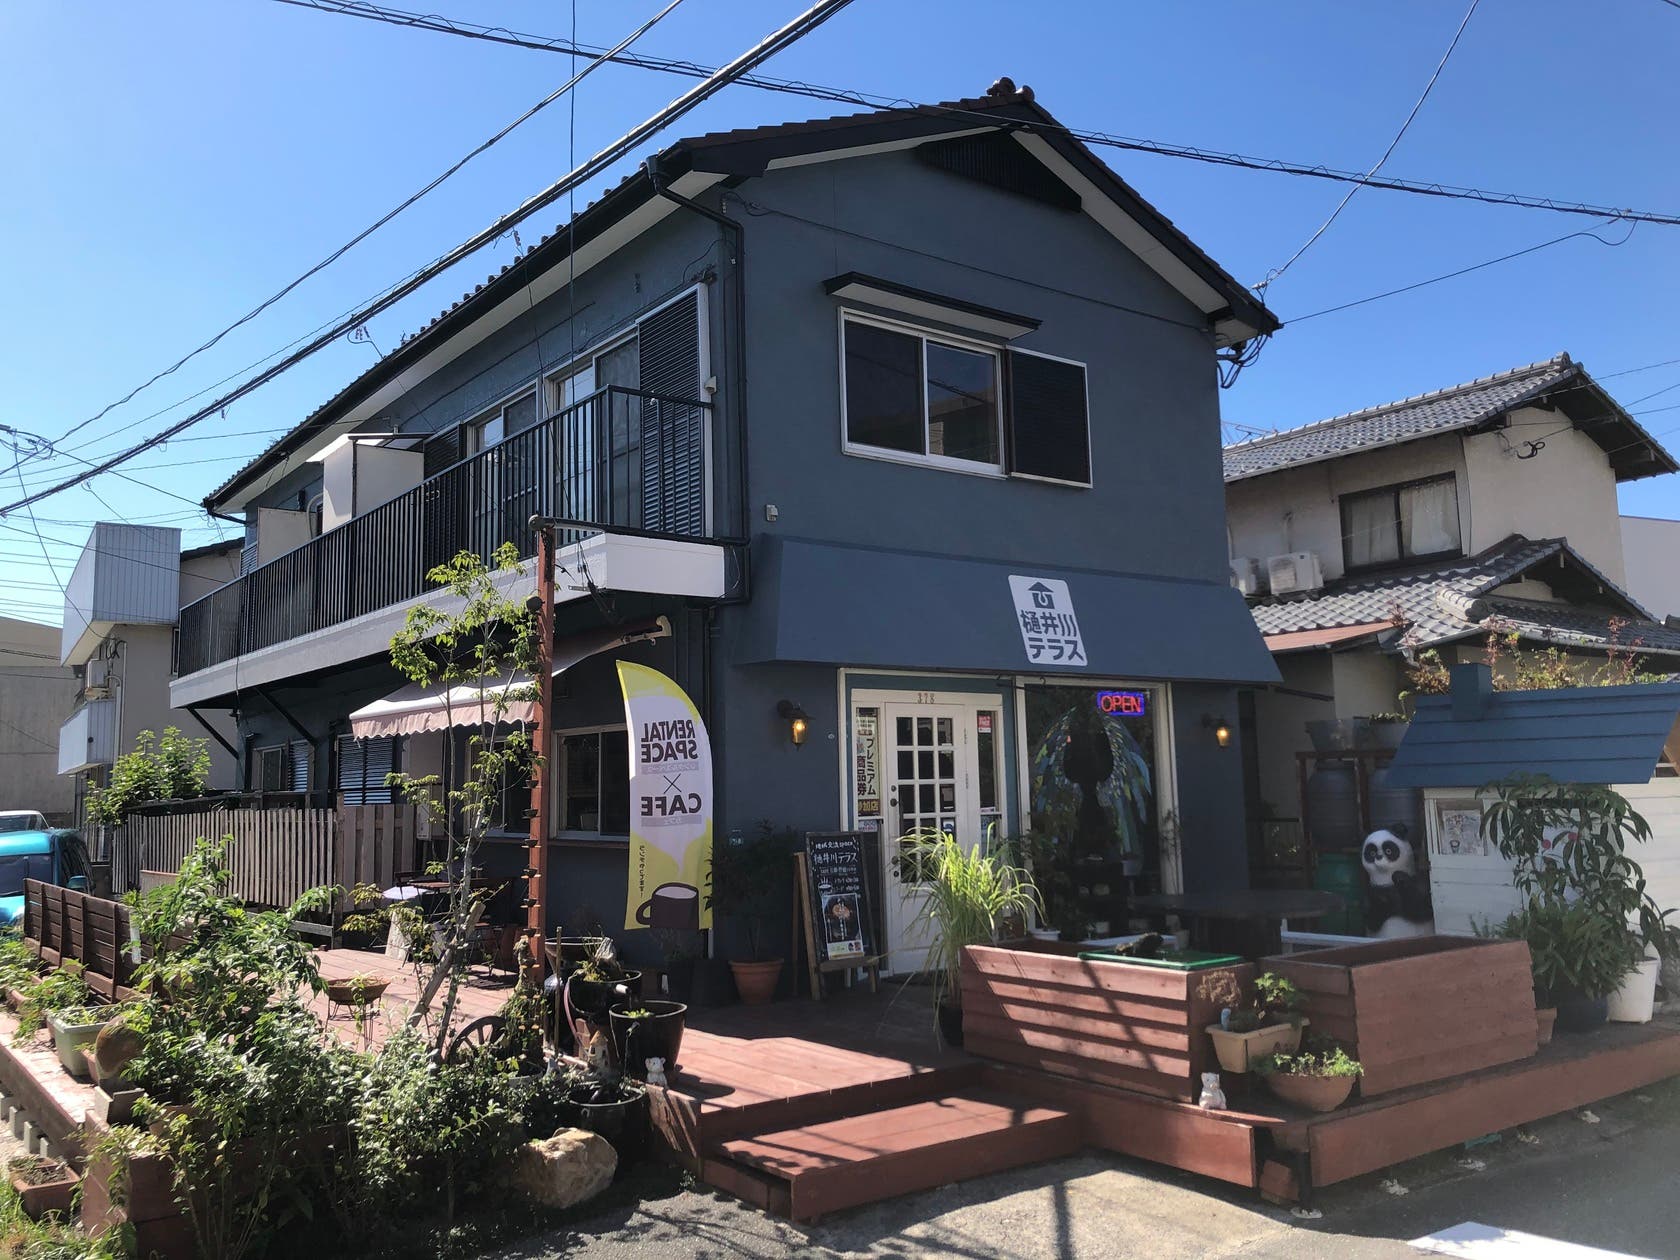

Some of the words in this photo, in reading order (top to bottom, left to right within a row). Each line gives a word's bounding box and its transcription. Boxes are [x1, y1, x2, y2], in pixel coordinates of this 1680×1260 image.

[1020, 610, 1077, 637] 樋井川
[1028, 637, 1084, 661] テラス
[1101, 695, 1141, 713] OPEN
[856, 755, 867, 796] 商品券
